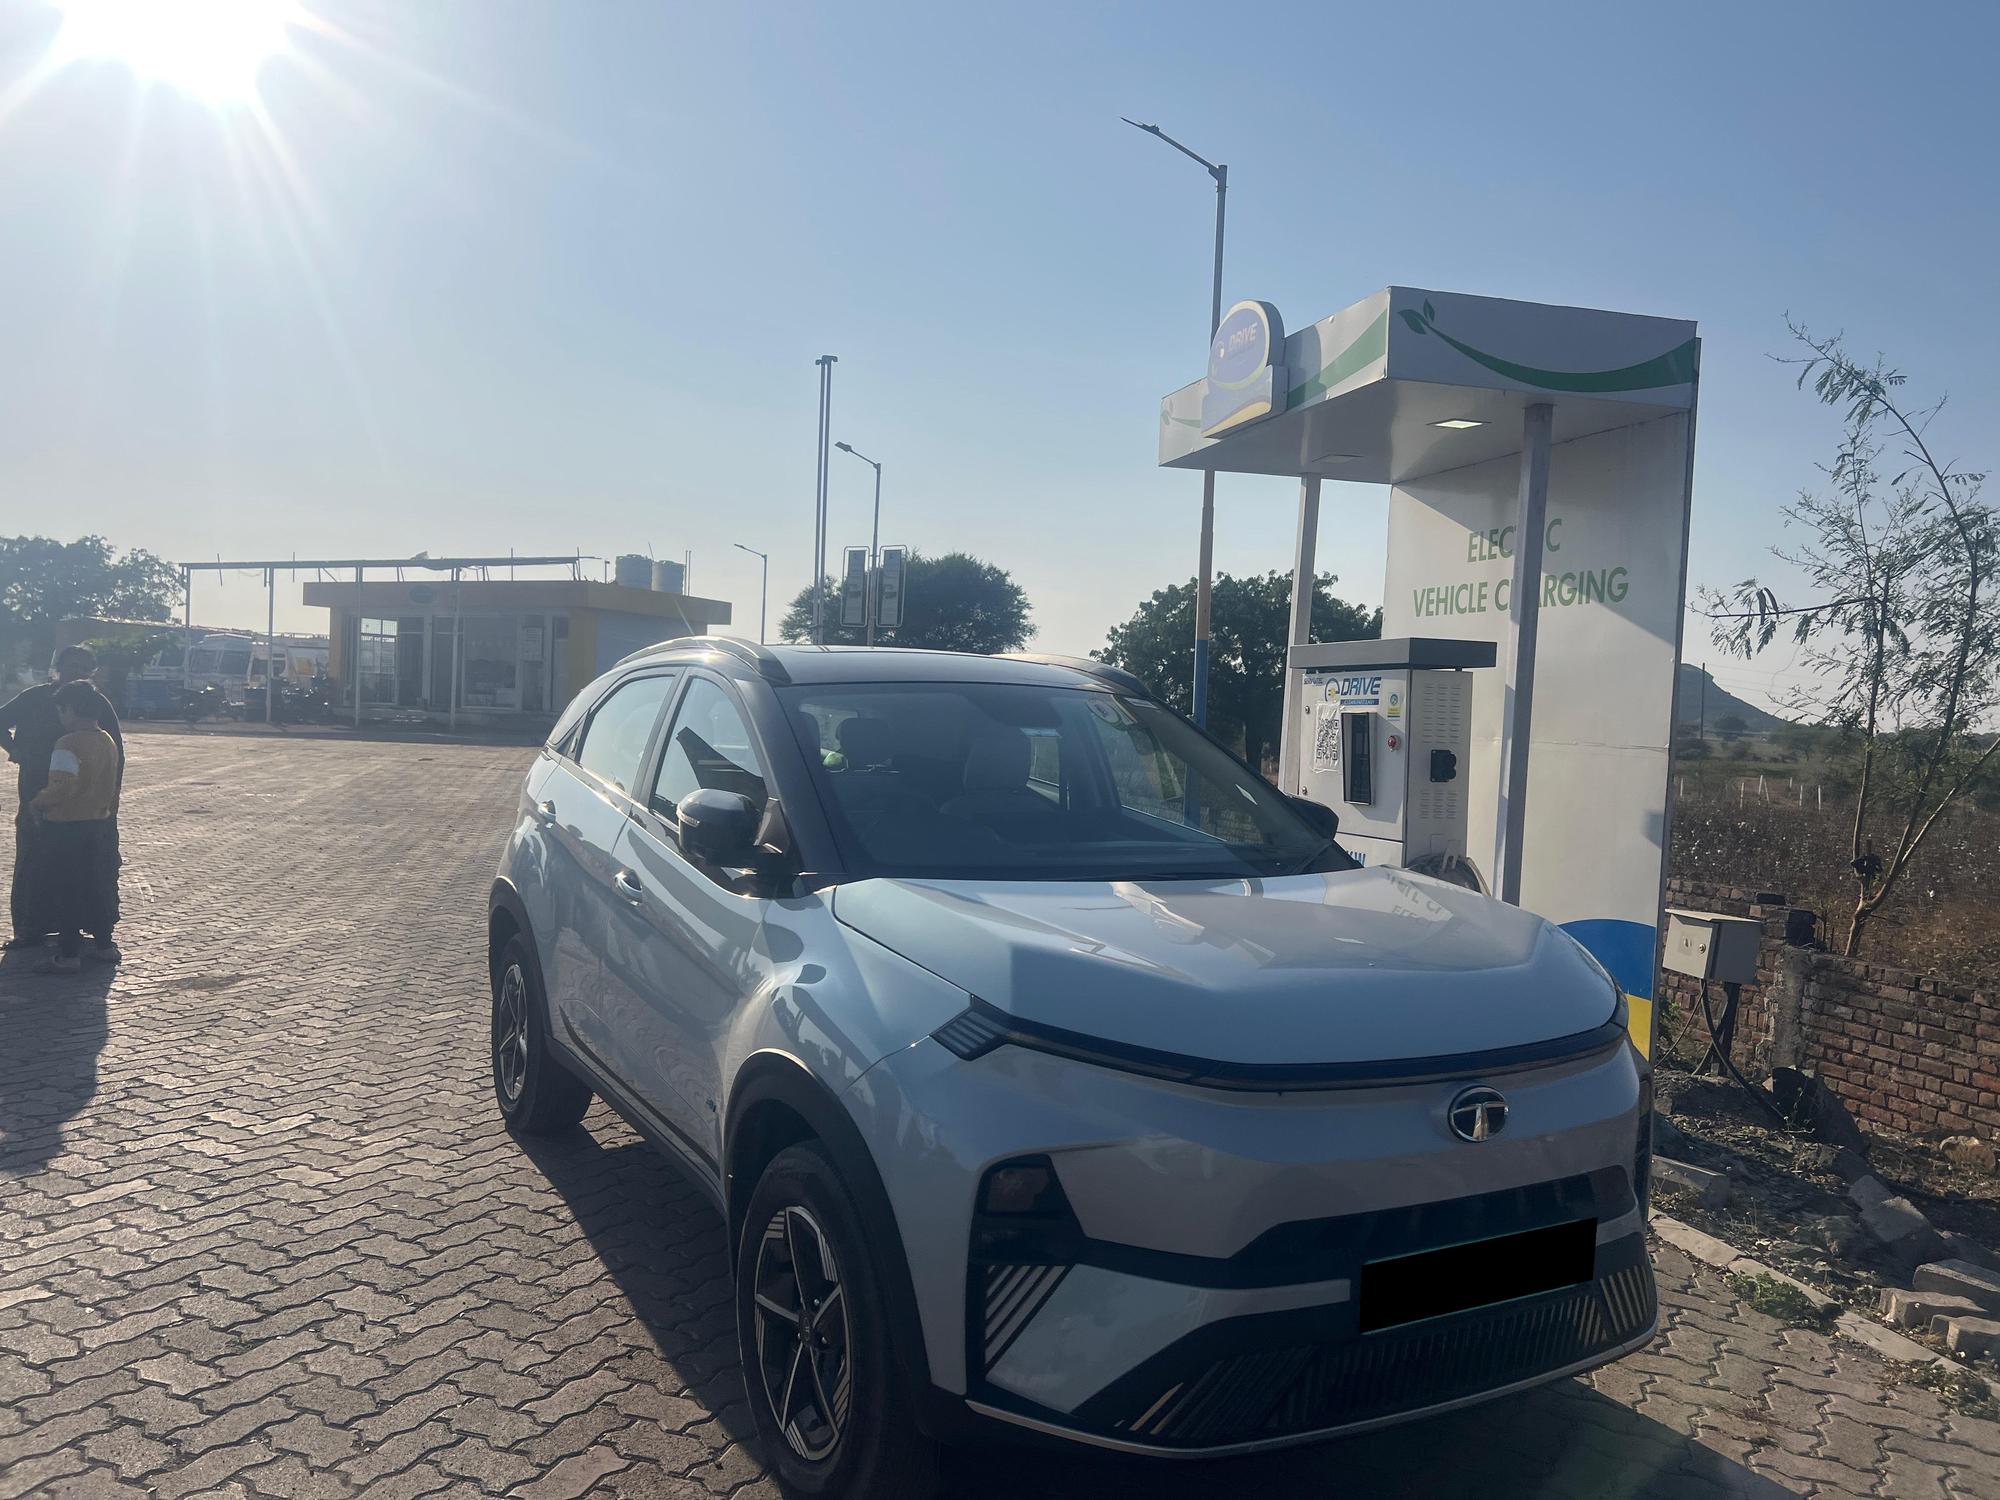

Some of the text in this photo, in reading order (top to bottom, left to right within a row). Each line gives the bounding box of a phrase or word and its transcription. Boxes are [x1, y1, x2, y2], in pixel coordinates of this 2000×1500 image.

[1229, 321, 1258, 350] DRIVE
[1467, 518, 1562, 563] ELECC
[1413, 566, 1629, 617] VEHICLE CRGING
[1341, 676, 1382, 696] DRIVE
